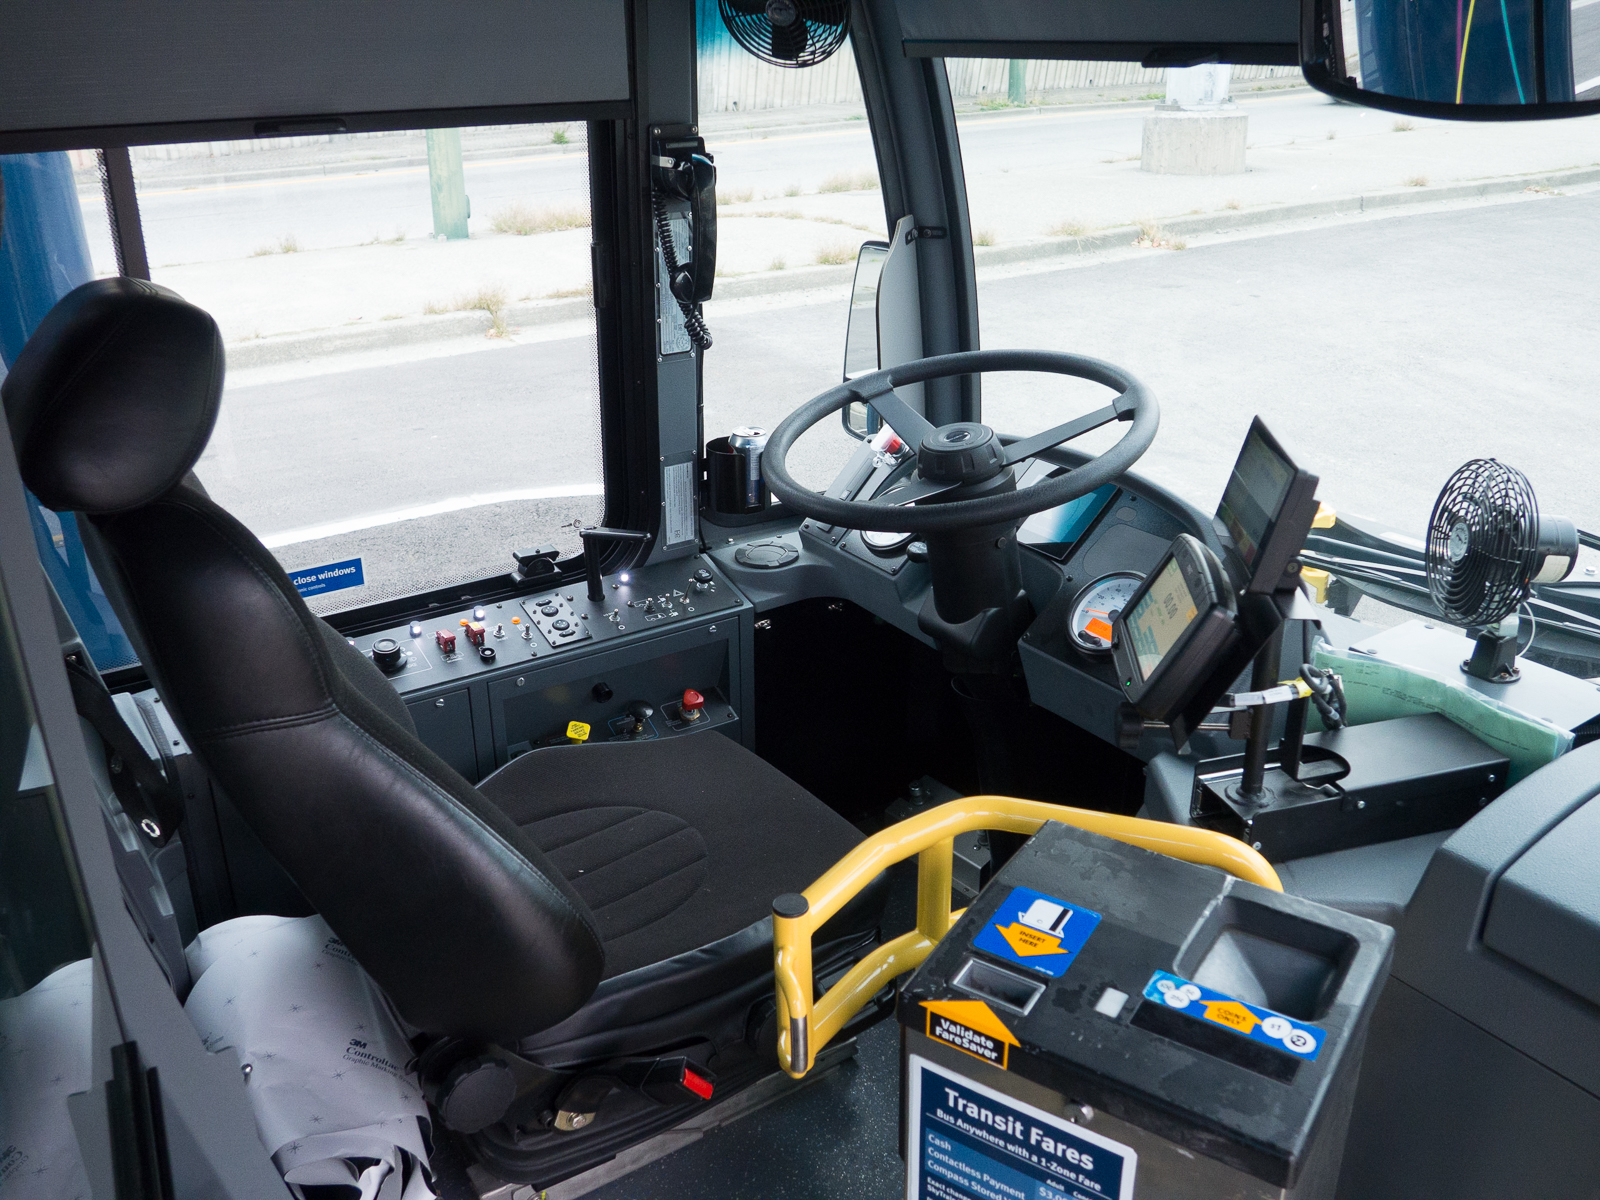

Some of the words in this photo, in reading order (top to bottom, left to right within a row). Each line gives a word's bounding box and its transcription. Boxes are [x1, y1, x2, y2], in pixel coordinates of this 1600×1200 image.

[293, 575, 317, 586] close
[318, 566, 356, 580] windows
[308, 583, 326, 591] controls
[1018, 938, 1038, 948] HERE
[1019, 931, 1046, 944] INSERT
[1216, 1013, 1242, 1026] ONLY
[1217, 1007, 1247, 1022] COINS
[349, 1038, 367, 1049] 3M
[935, 1025, 998, 1060] FareSaver
[940, 1018, 994, 1050] Validate
[342, 1054, 370, 1067] Graphic
[371, 1062, 399, 1077] Marking
[346, 1046, 400, 1071] Controltac
[944, 1087, 1025, 1141] Transit
[1030, 1125, 1094, 1171] Fares
[928, 1133, 952, 1152] Cash
[936, 1108, 955, 1125] Bus
[956, 1117, 1006, 1149] Anywhere
[1006, 1141, 1029, 1159] with
[1031, 1154, 1038, 1163] a
[1040, 1157, 1077, 1180] 1-Zone
[1078, 1174, 1102, 1192] Fare
[928, 1146, 982, 1179] Contactless
[983, 1173, 1025, 1200] Payment
[928, 1160, 969, 1186] Compass
[971, 1181, 1002, 1200] Stored
[927, 1176, 946, 1191] Exact
[946, 1187, 972, 1200] chang
[1039, 1186, 1067, 1200] $3.0
[1046, 1179, 1065, 1192] Adult
